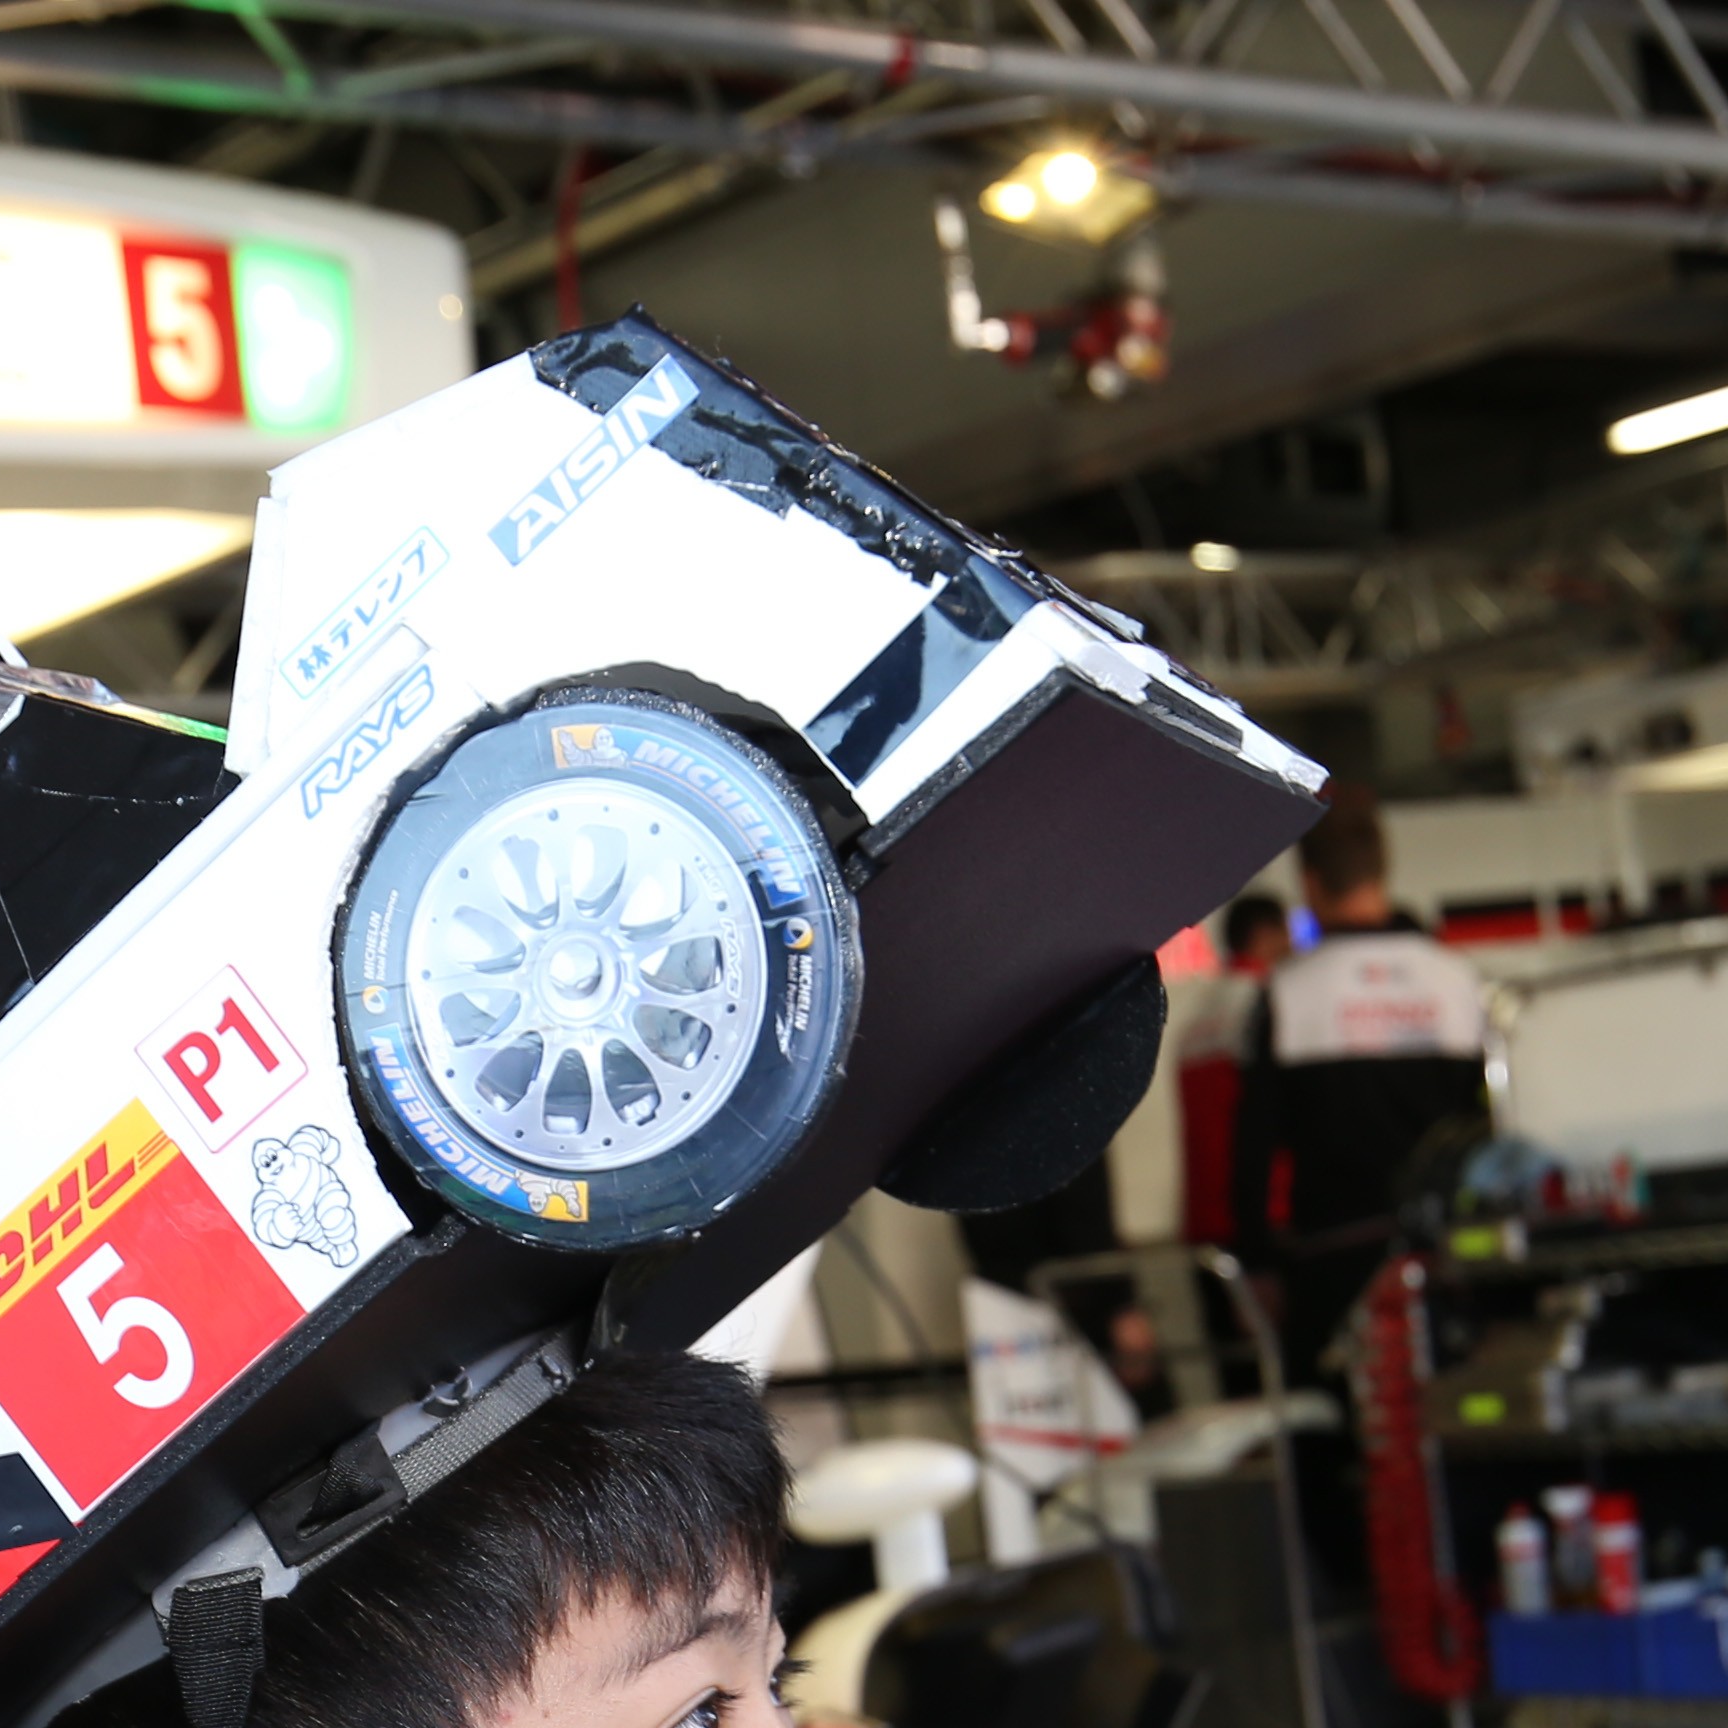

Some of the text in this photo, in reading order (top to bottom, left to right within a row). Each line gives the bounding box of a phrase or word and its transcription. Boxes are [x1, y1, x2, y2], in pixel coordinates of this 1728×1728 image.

[141, 256, 224, 399] 5
[509, 369, 684, 558] AISIN
[297, 539, 428, 681] 林テレンプ
[301, 664, 434, 819] RAYS
[634, 740, 802, 893] MICHELIN
[364, 910, 382, 980] MICHELIN
[795, 955, 812, 1031] MICHELIN
[161, 996, 280, 1122] P1
[371, 1036, 512, 1195] MICHELIN
[56, 1241, 195, 1409] 5
